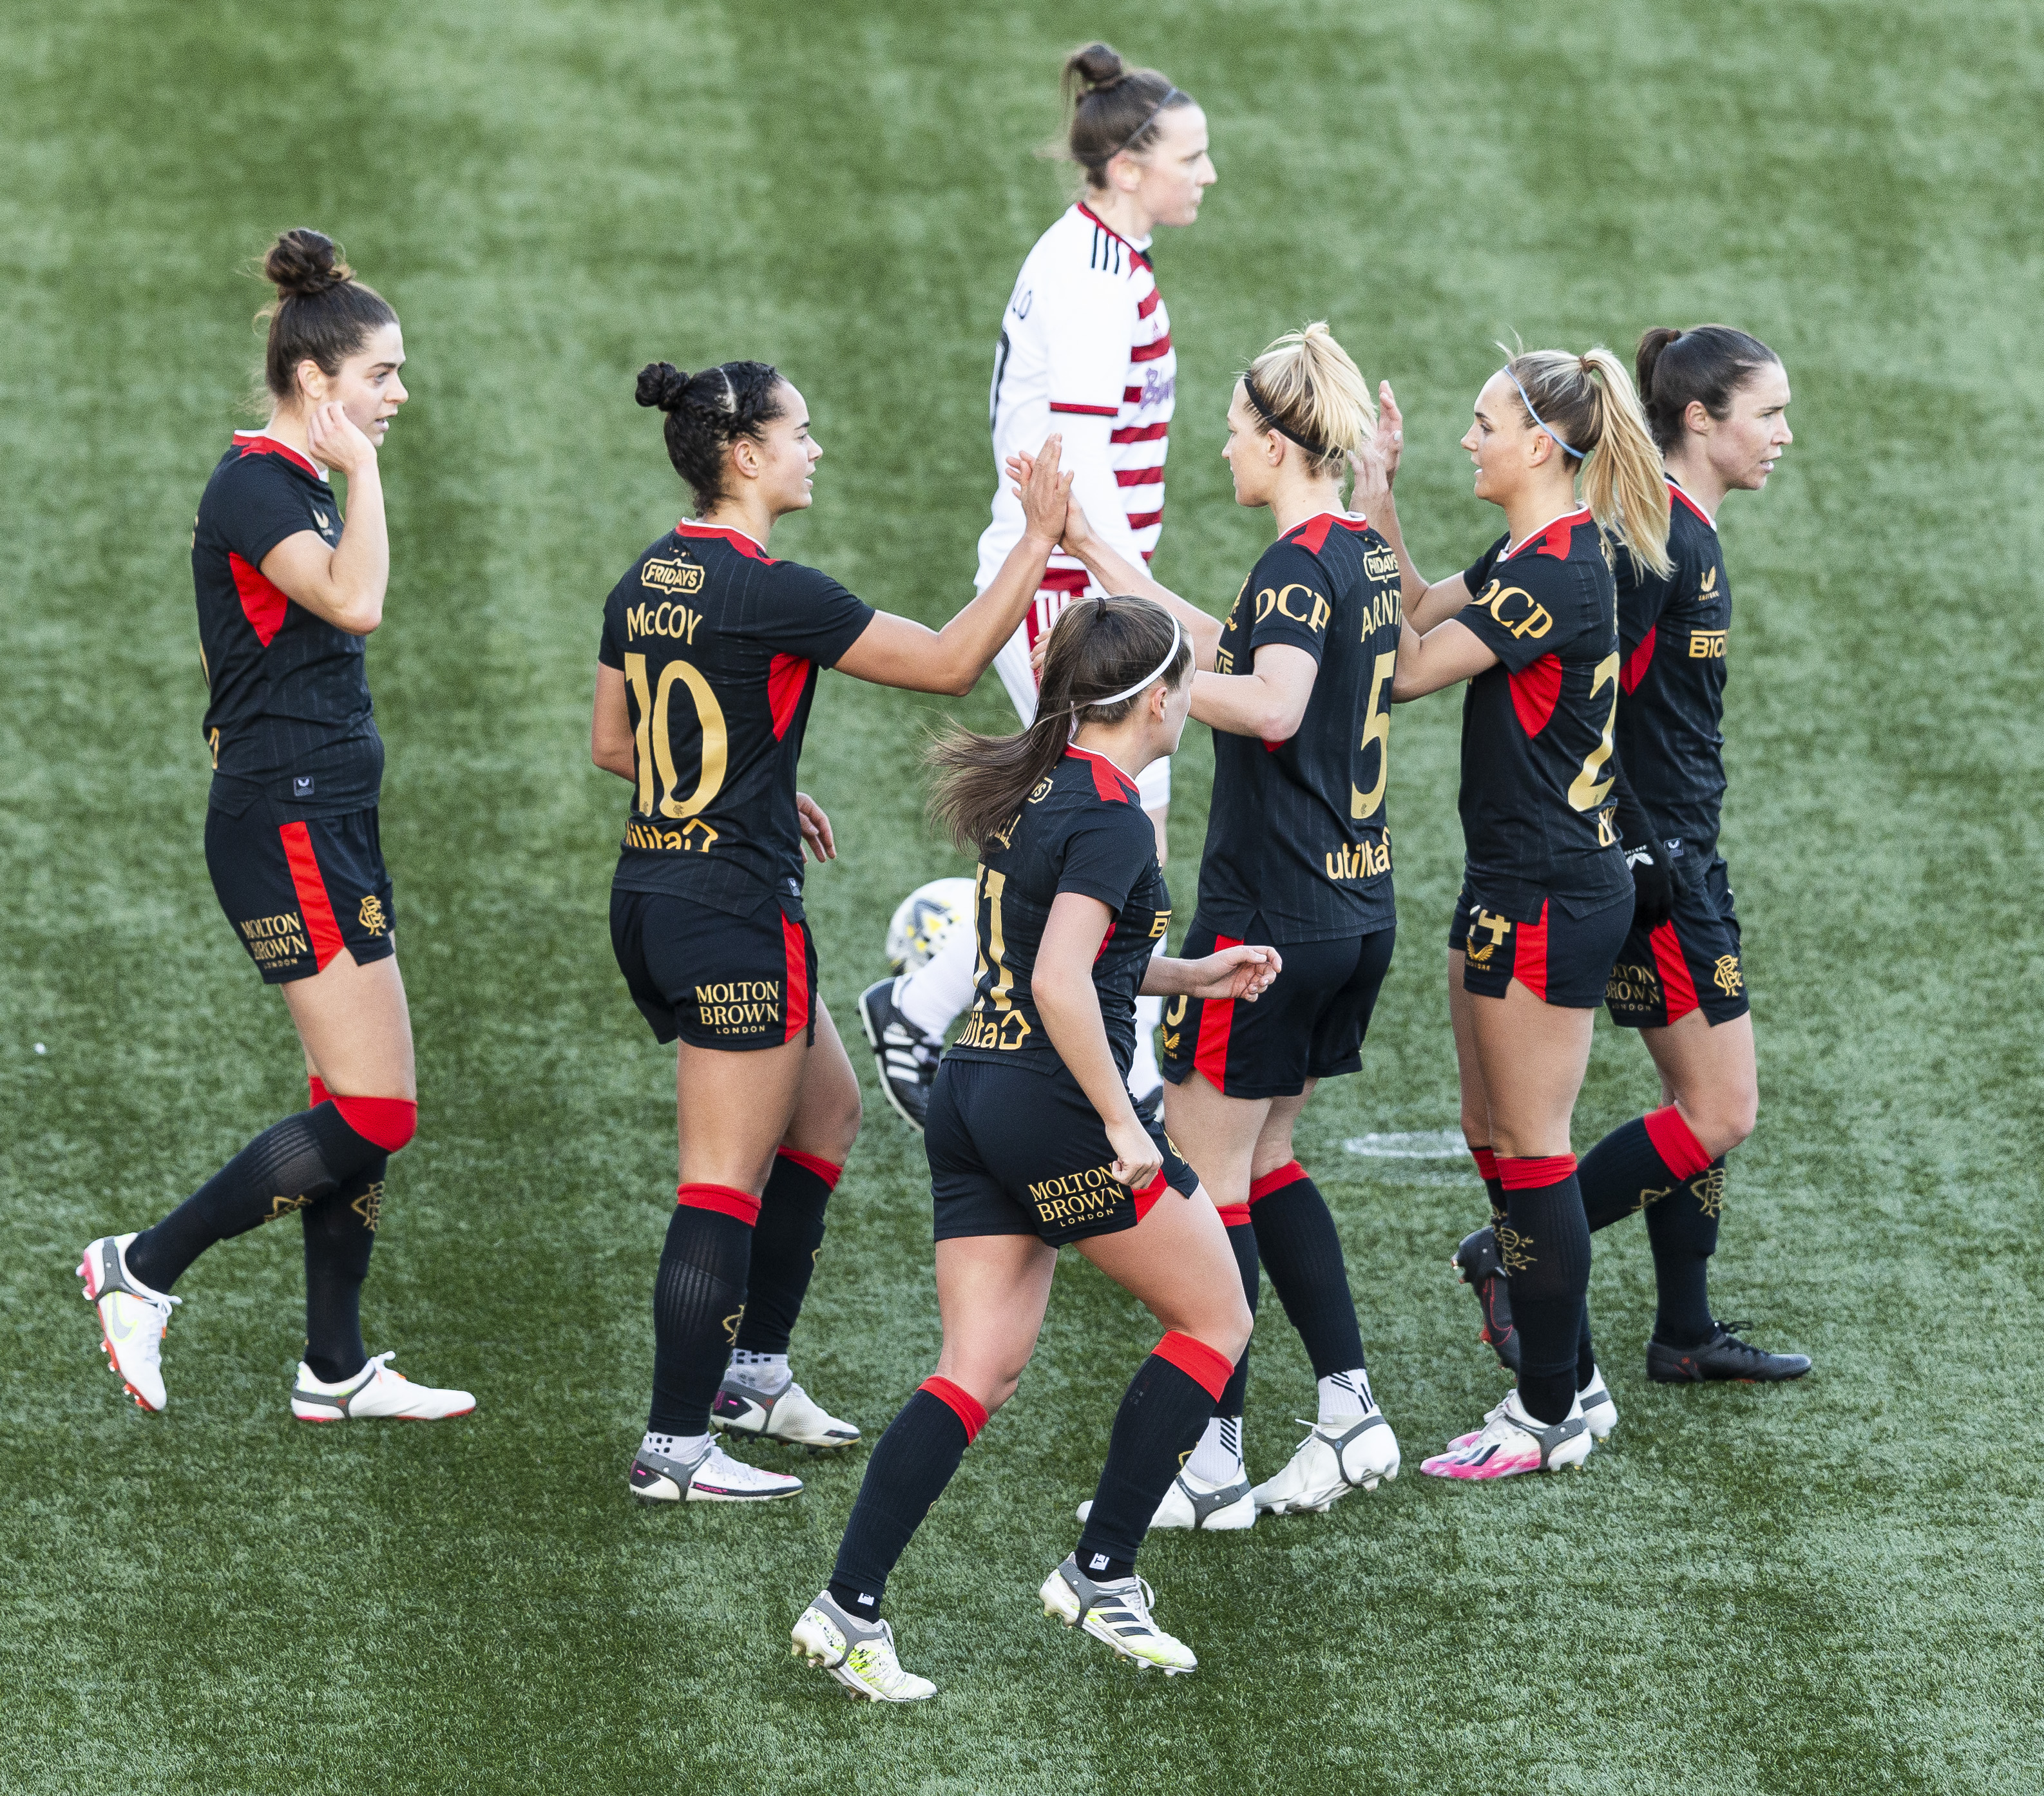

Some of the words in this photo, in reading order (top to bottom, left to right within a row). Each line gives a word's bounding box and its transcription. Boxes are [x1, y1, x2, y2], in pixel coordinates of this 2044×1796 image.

[645, 564, 698, 588] FRIDAYS
[626, 601, 703, 645] McCOY
[1688, 636, 1726, 658] BIO
[624, 652, 729, 819] 10
[1350, 650, 1397, 820] 5
[240, 912, 301, 939] MOLTON
[249, 933, 308, 960] BROWN
[694, 980, 779, 1004] MOLTON
[699, 1002, 779, 1026] BROWN
[715, 1025, 766, 1035] LONDON
[1027, 1162, 1116, 1202] MOLTON
[1036, 1183, 1126, 1223] BROWN
[1060, 1208, 1114, 1227] LONDON
